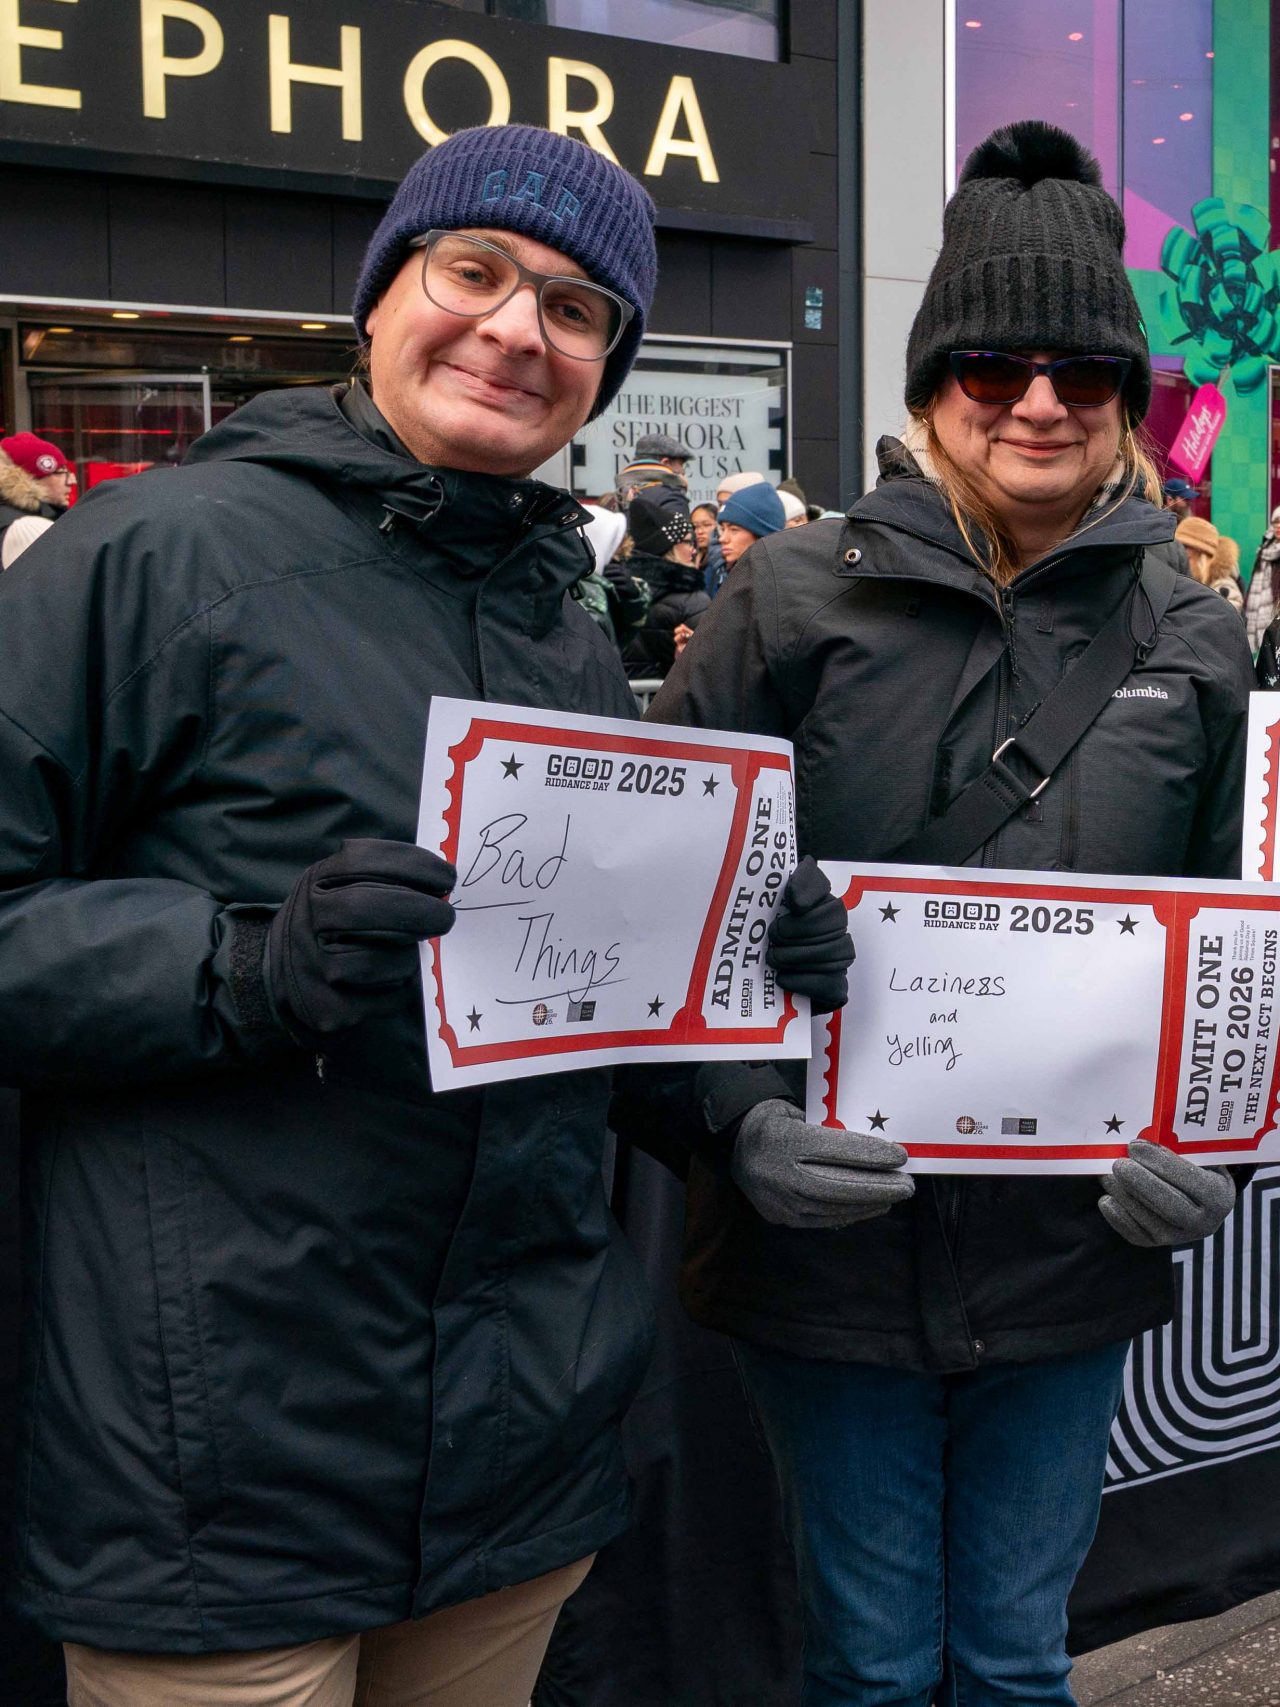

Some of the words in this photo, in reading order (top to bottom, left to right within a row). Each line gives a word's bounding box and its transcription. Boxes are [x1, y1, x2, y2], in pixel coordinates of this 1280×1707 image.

[482, 169, 581, 224] GAP
[616, 393, 655, 415] THE
[660, 396, 743, 418] BIGGEST
[698, 455, 743, 479] USA
[1112, 686, 1168, 699] olumbia
[544, 777, 591, 790] RIDDANCE
[592, 780, 611, 792] DAY
[547, 753, 614, 781] GOOD
[616, 761, 687, 797] 2025
[461, 813, 570, 889] Bad
[711, 886, 755, 1010] ADMIT
[745, 796, 772, 875] ONE
[742, 920, 767, 969] TO
[759, 831, 787, 908] 2026
[924, 900, 1001, 922] GOOD
[1009, 905, 1094, 936] 2025
[923, 919, 976, 930] RIDDANCE
[979, 922, 1000, 931] DAY
[515, 913, 621, 1004] Things
[1196, 935, 1223, 1010] ONE
[1261, 929, 1278, 999] BEGINS
[763, 970, 775, 1009] THE
[889, 968, 1006, 996] Laziness
[929, 1008, 958, 1024] and
[1226, 966, 1255, 1040] 2026
[1256, 1003, 1273, 1040] ACT
[1183, 1018, 1217, 1127] ADMIT
[1219, 1049, 1246, 1093] TO
[1249, 1043, 1268, 1089] NEXT
[1217, 1100, 1231, 1132] GOOD
[1243, 1092, 1260, 1124] THE
